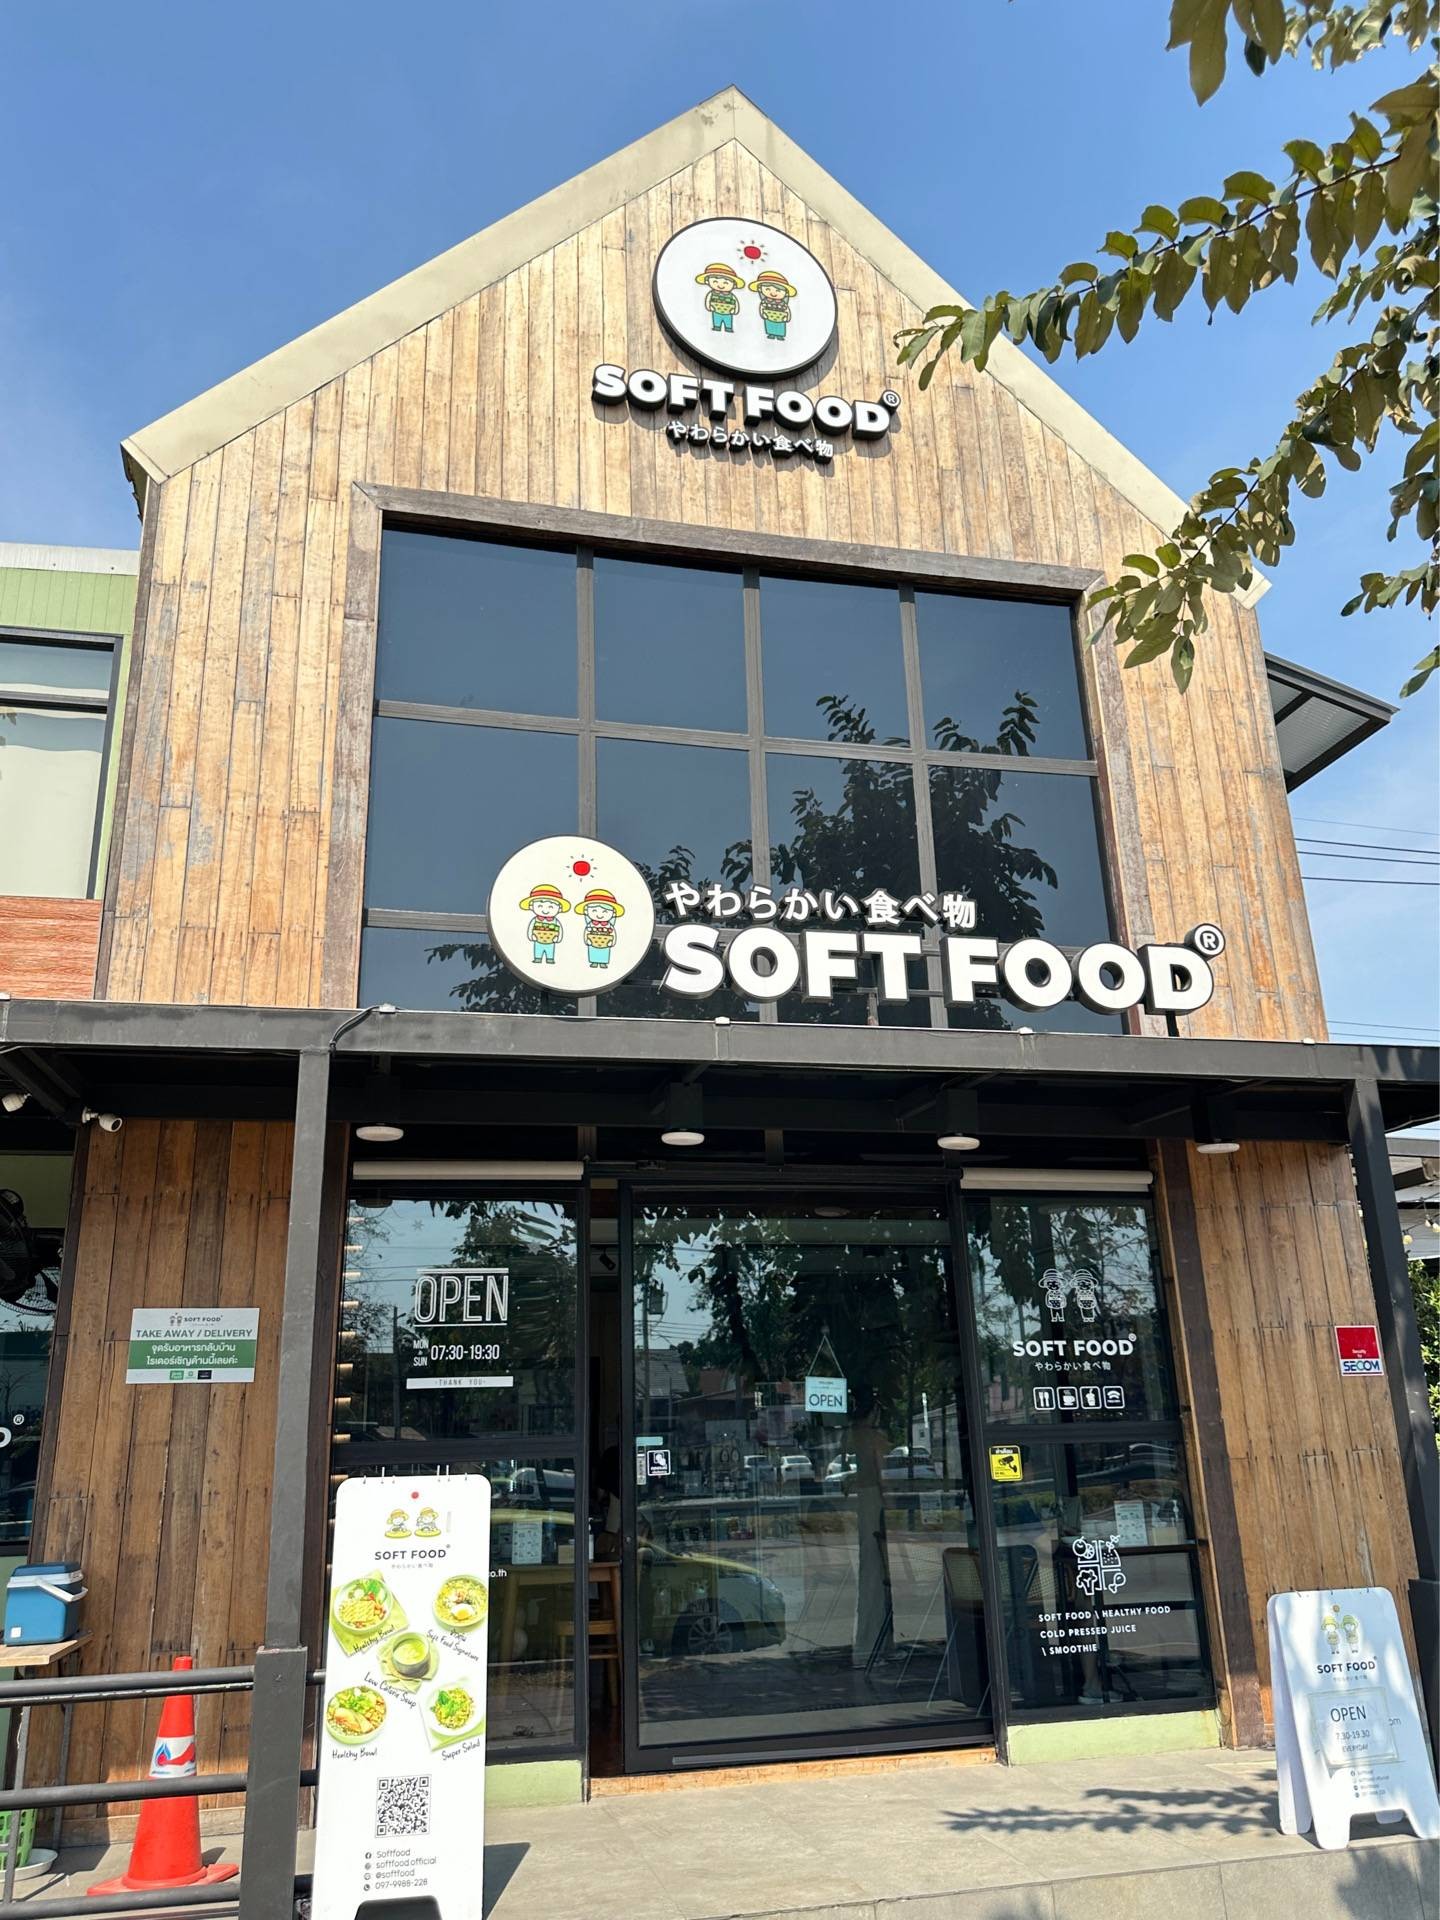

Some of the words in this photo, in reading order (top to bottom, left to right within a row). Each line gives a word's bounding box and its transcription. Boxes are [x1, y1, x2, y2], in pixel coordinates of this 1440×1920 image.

[592, 363, 734, 416] SOFT
[666, 420, 833, 460] やわらかい食べ物
[665, 881, 977, 929] やわらかい食べ物
[662, 924, 923, 1004] SOFT
[414, 1275, 508, 1323] OPEN
[136, 1329, 161, 1338] TAKE
[164, 1329, 195, 1338] AWAY
[204, 1329, 253, 1338] DELIVERY
[413, 1338, 429, 1349] MON
[1012, 1339, 1067, 1357] SOFT
[430, 1344, 500, 1360] 07:30-19:30
[413, 1356, 428, 1366] SUN
[1034, 1361, 1111, 1371] やわらかい食べ物
[1343, 1360, 1380, 1371] SECOM
[809, 1393, 843, 1407] OPEN
[374, 1551, 407, 1560] SOFT
[488, 1568, 507, 1578] o.th
[1038, 1613, 1062, 1622] SOFT
[1065, 1611, 1092, 1620] FOOD
[1102, 1607, 1142, 1617] HEALTHY
[1145, 1605, 1171, 1615] FOOD
[1040, 1629, 1066, 1639] COLD
[1068, 1626, 1108, 1637] PRESSED
[1110, 1624, 1137, 1634] JUICE
[1049, 1643, 1098, 1655] SMOOTHIE
[1317, 1663, 1343, 1674] SOFT
[364, 1672, 379, 1687] Low
[400, 1692, 417, 1709] Soup
[1330, 1705, 1367, 1722] OPEN
[332, 1750, 358, 1760] Healthy
[441, 1747, 461, 1761] Super
